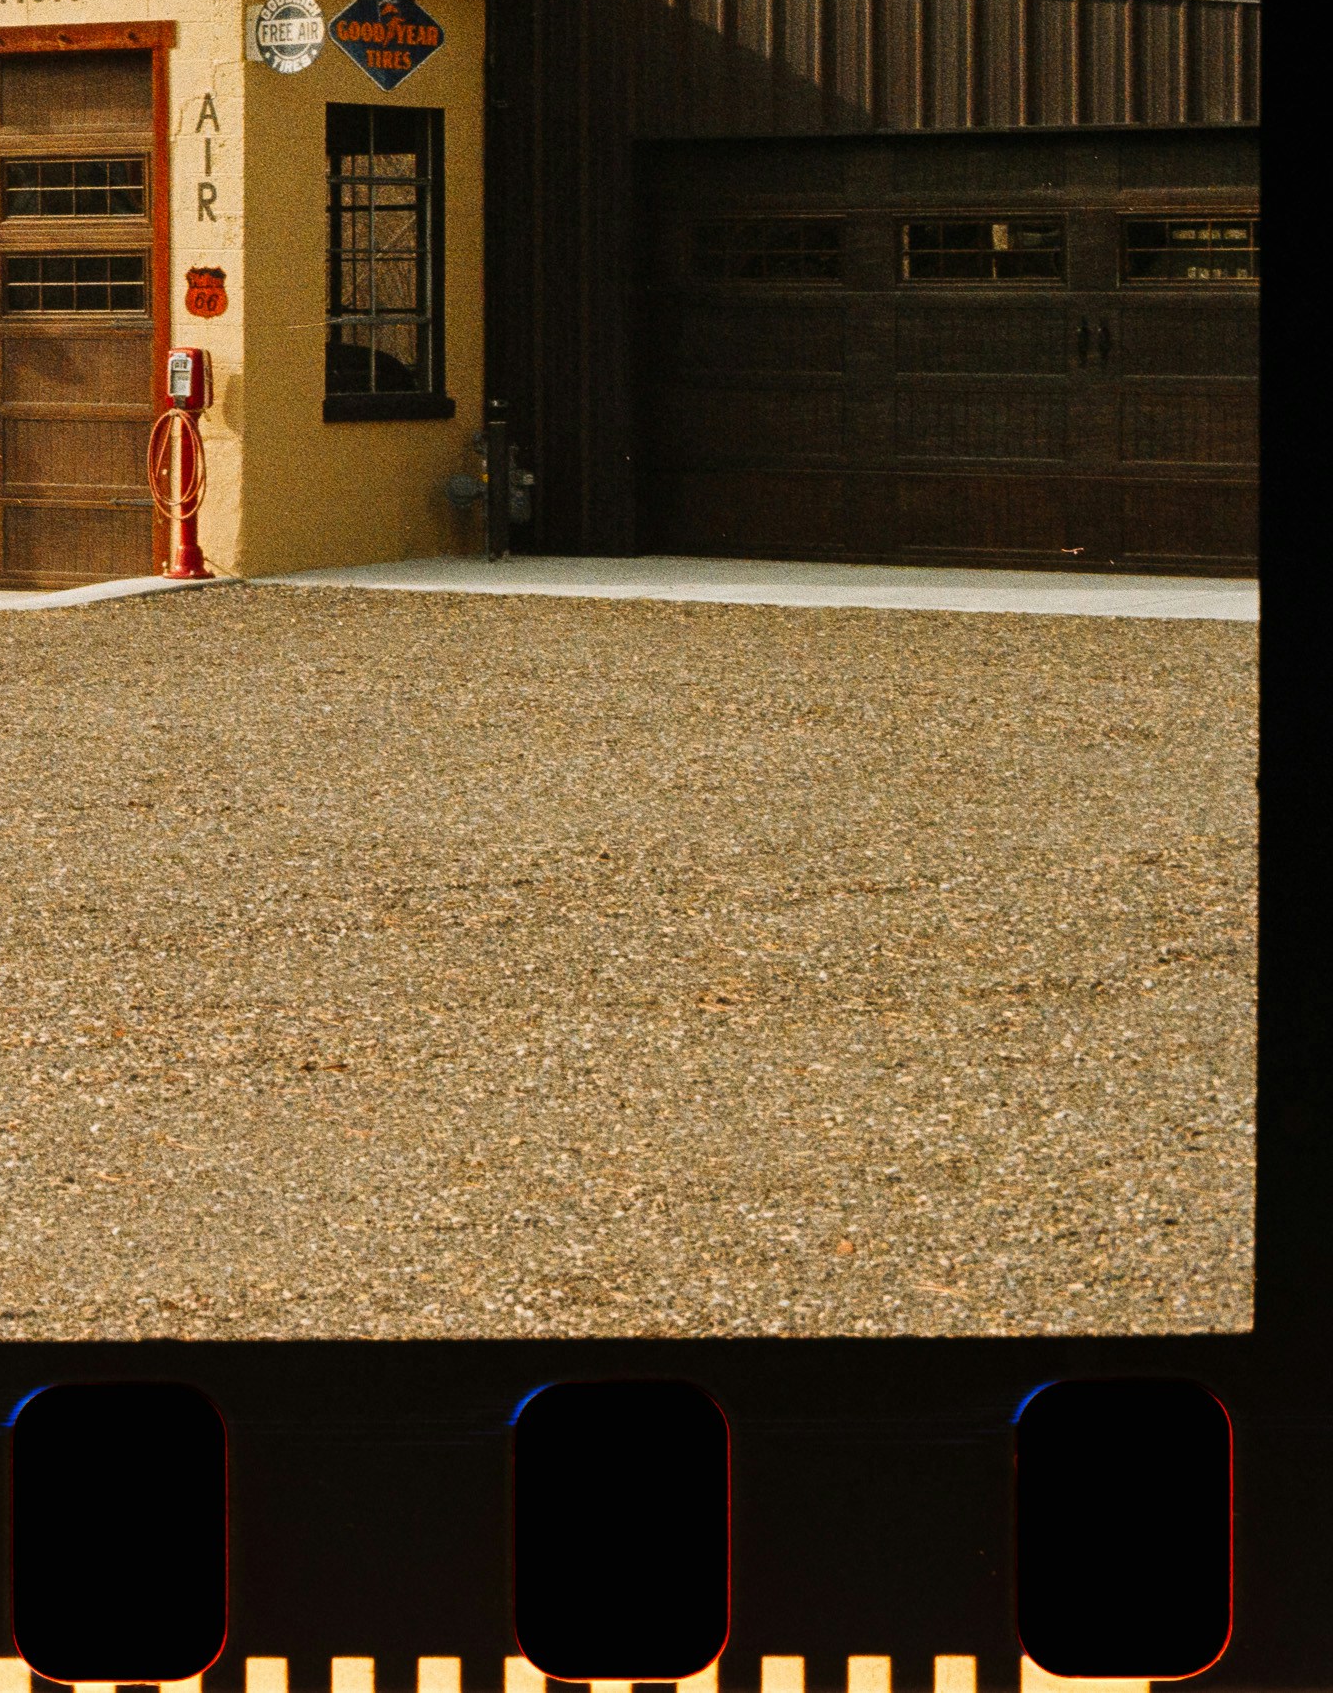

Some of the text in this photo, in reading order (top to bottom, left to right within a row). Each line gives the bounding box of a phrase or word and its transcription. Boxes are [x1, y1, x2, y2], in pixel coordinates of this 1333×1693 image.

[262, 21, 320, 43] FREE AIR
[336, 18, 440, 47] GOODYEAR
[272, 54, 312, 74] TIRES
[366, 49, 412, 70] TIRES
[195, 93, 220, 223] AIR
[195, 292, 220, 312] 66
